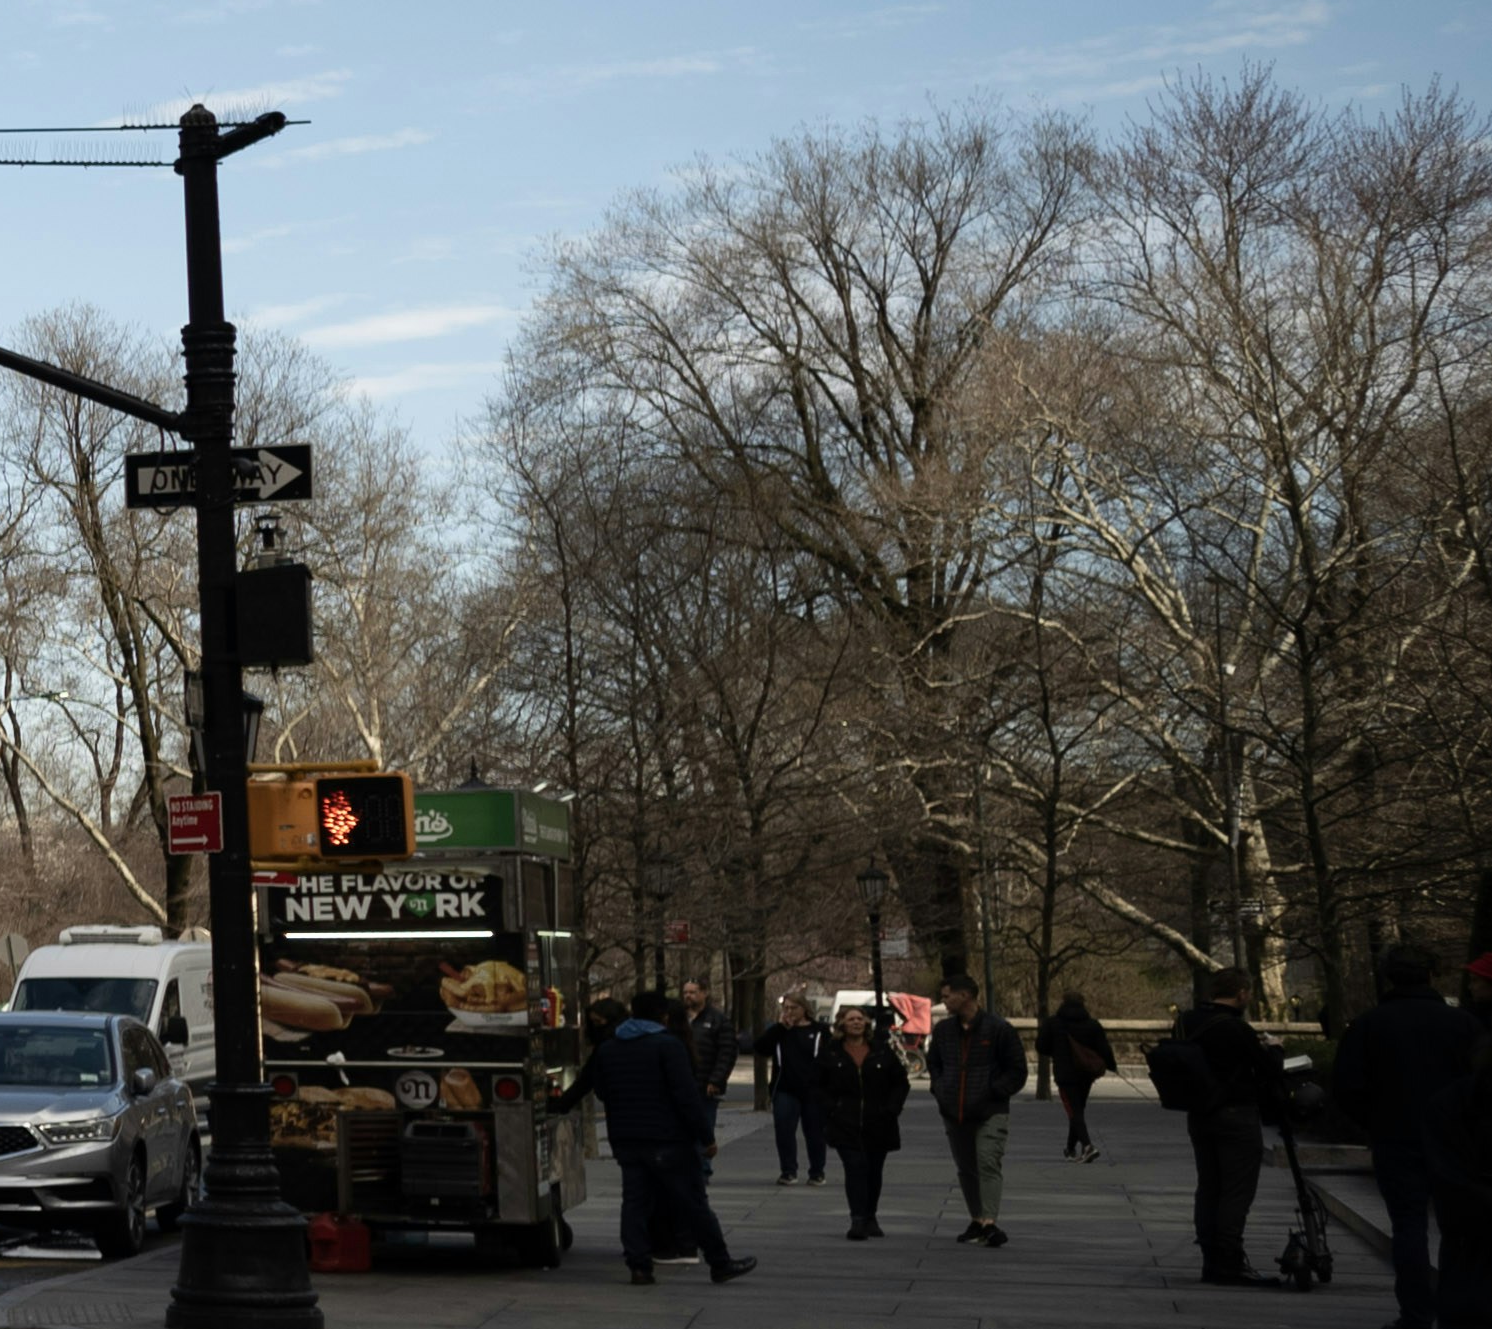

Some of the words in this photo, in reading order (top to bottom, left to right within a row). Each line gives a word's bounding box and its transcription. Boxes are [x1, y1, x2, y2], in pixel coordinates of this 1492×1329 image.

[170, 801, 181, 813] NO
[171, 815, 199, 828] Anytime
[342, 874, 442, 893] FLAVOR
[449, 874, 485, 890] OF
[285, 895, 372, 921] NEW
